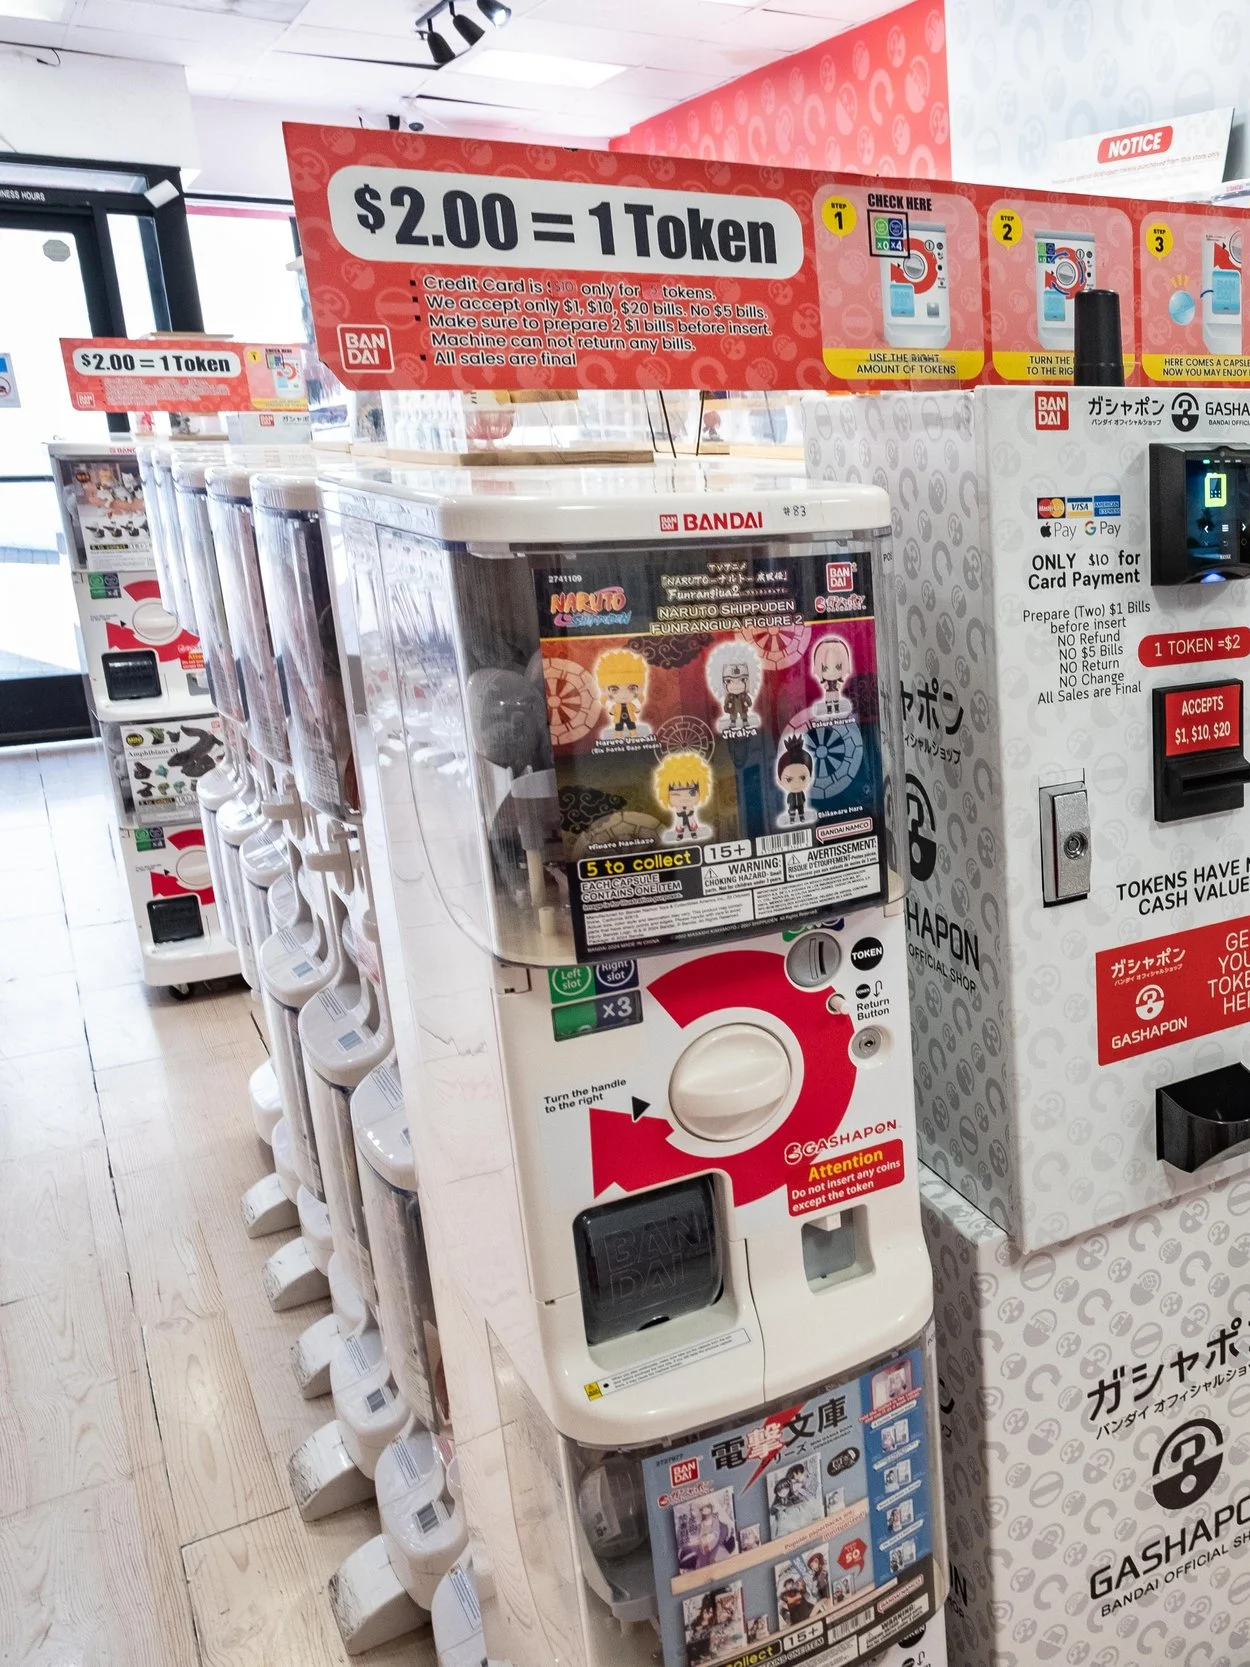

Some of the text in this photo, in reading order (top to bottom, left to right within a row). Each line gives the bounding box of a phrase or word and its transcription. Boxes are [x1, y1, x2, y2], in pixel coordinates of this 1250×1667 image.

[1108, 132, 1162, 158] NOTICE
[868, 193, 932, 211] CHECK HERE
[354, 184, 777, 264] $2.00 = 1 Token
[424, 276, 479, 291] Credit
[482, 278, 525, 293] Card
[529, 279, 543, 293] is
[582, 283, 614, 300] only
[619, 282, 639, 297] for
[662, 285, 716, 299] tokens.
[426, 295, 768, 319] We accept only $1, $10, $20 bills. No $5 bills.
[81, 352, 135, 372] $2.00
[160, 355, 169, 372] 1
[172, 355, 230, 373] Token
[434, 352, 576, 366] All sales are final
[1164, 358, 1185, 368] HERE
[1186, 358, 1213, 368] COMES
[1215, 359, 1222, 367] A
[1162, 368, 1183, 377] NOW
[1184, 368, 1200, 377] YOU
[1202, 368, 1221, 377] MAY
[1223, 368, 1246, 377] ENJOY
[1037, 396, 1066, 412] BAN
[1088, 397, 1165, 417] ガシャポン
[1038, 412, 1061, 426] DAI
[783, 506, 807, 517] #83
[1071, 503, 1090, 511] VISA
[684, 512, 763, 531] BANDAI
[1032, 551, 1141, 571] ONLY $10 for
[1028, 568, 1140, 590] Card Payment
[659, 601, 795, 620] NARUTO SHIPPUDEN
[1023, 601, 1151, 624] Prepare (Two) $1 Bills
[651, 615, 803, 634] FUNRANGIUA FIGURE 2
[1050, 617, 1126, 634] before insert
[1057, 630, 1120, 647] NO Refund
[1154, 635, 1241, 657] 1 TOKEN =$2
[1182, 696, 1224, 715] ACCEPTS
[1175, 722, 1231, 745] $1, $10, $20
[128, 748, 169, 757] Amphibians
[711, 844, 746, 860] 15+
[807, 838, 877, 861] AVERTISSEMENT:
[587, 850, 691, 877] 5 to collect
[728, 857, 782, 875] WARNING:
[1116, 871, 1187, 900] TOKENS
[1194, 860, 1240, 885] HAVE
[1139, 876, 1250, 915] CASH VALUE
[851, 946, 883, 960] TOKEN
[1111, 947, 1185, 978] ガシャポン
[603, 996, 633, 1018] x3
[856, 997, 890, 1012] Return
[856, 1006, 890, 1021] Button
[1112, 1017, 1188, 1049] GASHAPON
[802, 1119, 896, 1156] GASHAPON
[808, 1150, 883, 1182] Attention
[792, 1160, 901, 1200] Do not insert any coins
[792, 1181, 874, 1212] except the token
[1101, 1579, 1160, 1617] BANDAI
[1164, 1543, 1230, 1584] OFFICIAL
